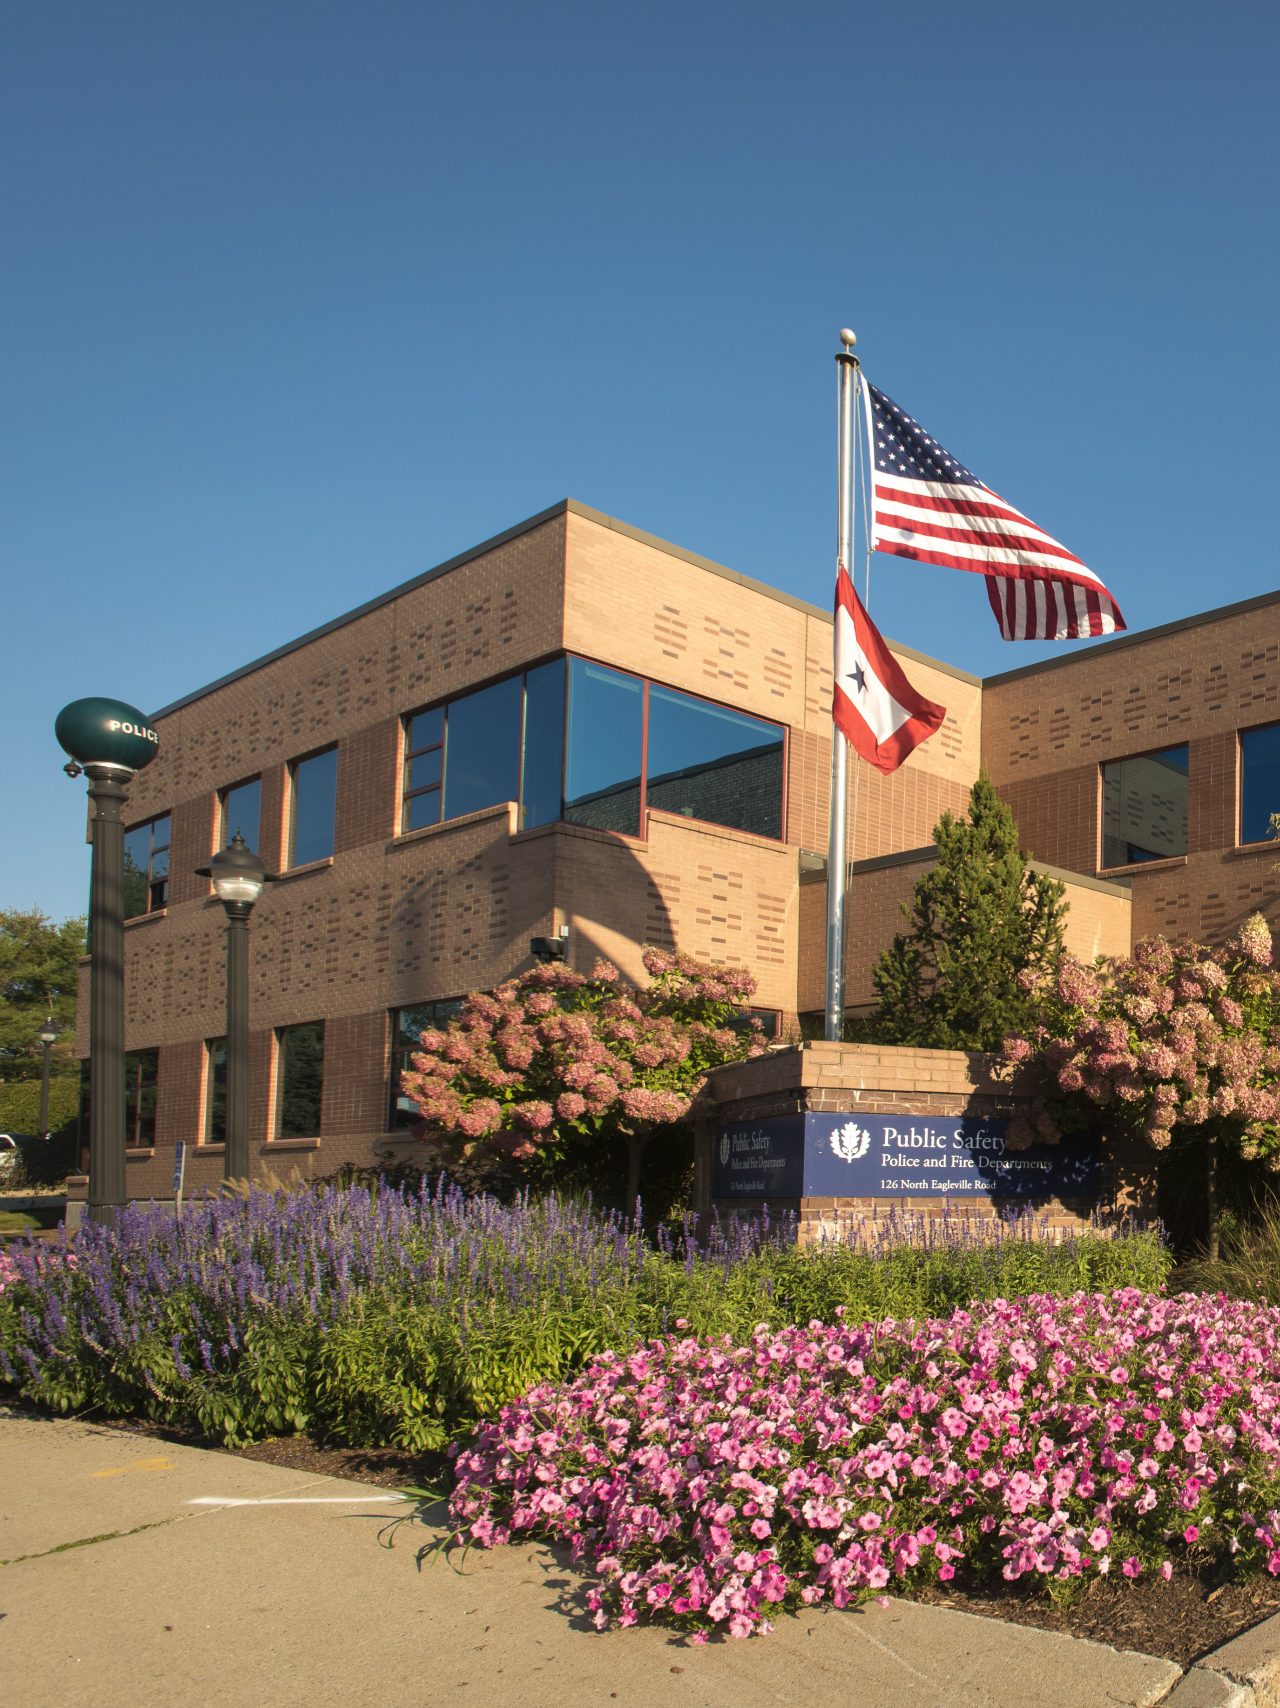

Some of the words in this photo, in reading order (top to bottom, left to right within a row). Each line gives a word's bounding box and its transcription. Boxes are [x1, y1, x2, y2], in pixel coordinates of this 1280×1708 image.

[110, 719, 159, 744] POLICE
[881, 1127, 947, 1148] Public
[952, 1129, 1007, 1156] Safety
[881, 1153, 920, 1168] Police
[923, 1154, 947, 1168] and
[950, 1155, 975, 1168] Fire
[978, 1155, 1053, 1172] Departments
[881, 1180, 898, 1189] 126
[900, 1180, 929, 1189] North
[931, 1180, 973, 1192] Eagleville
[974, 1180, 996, 1190] Road
